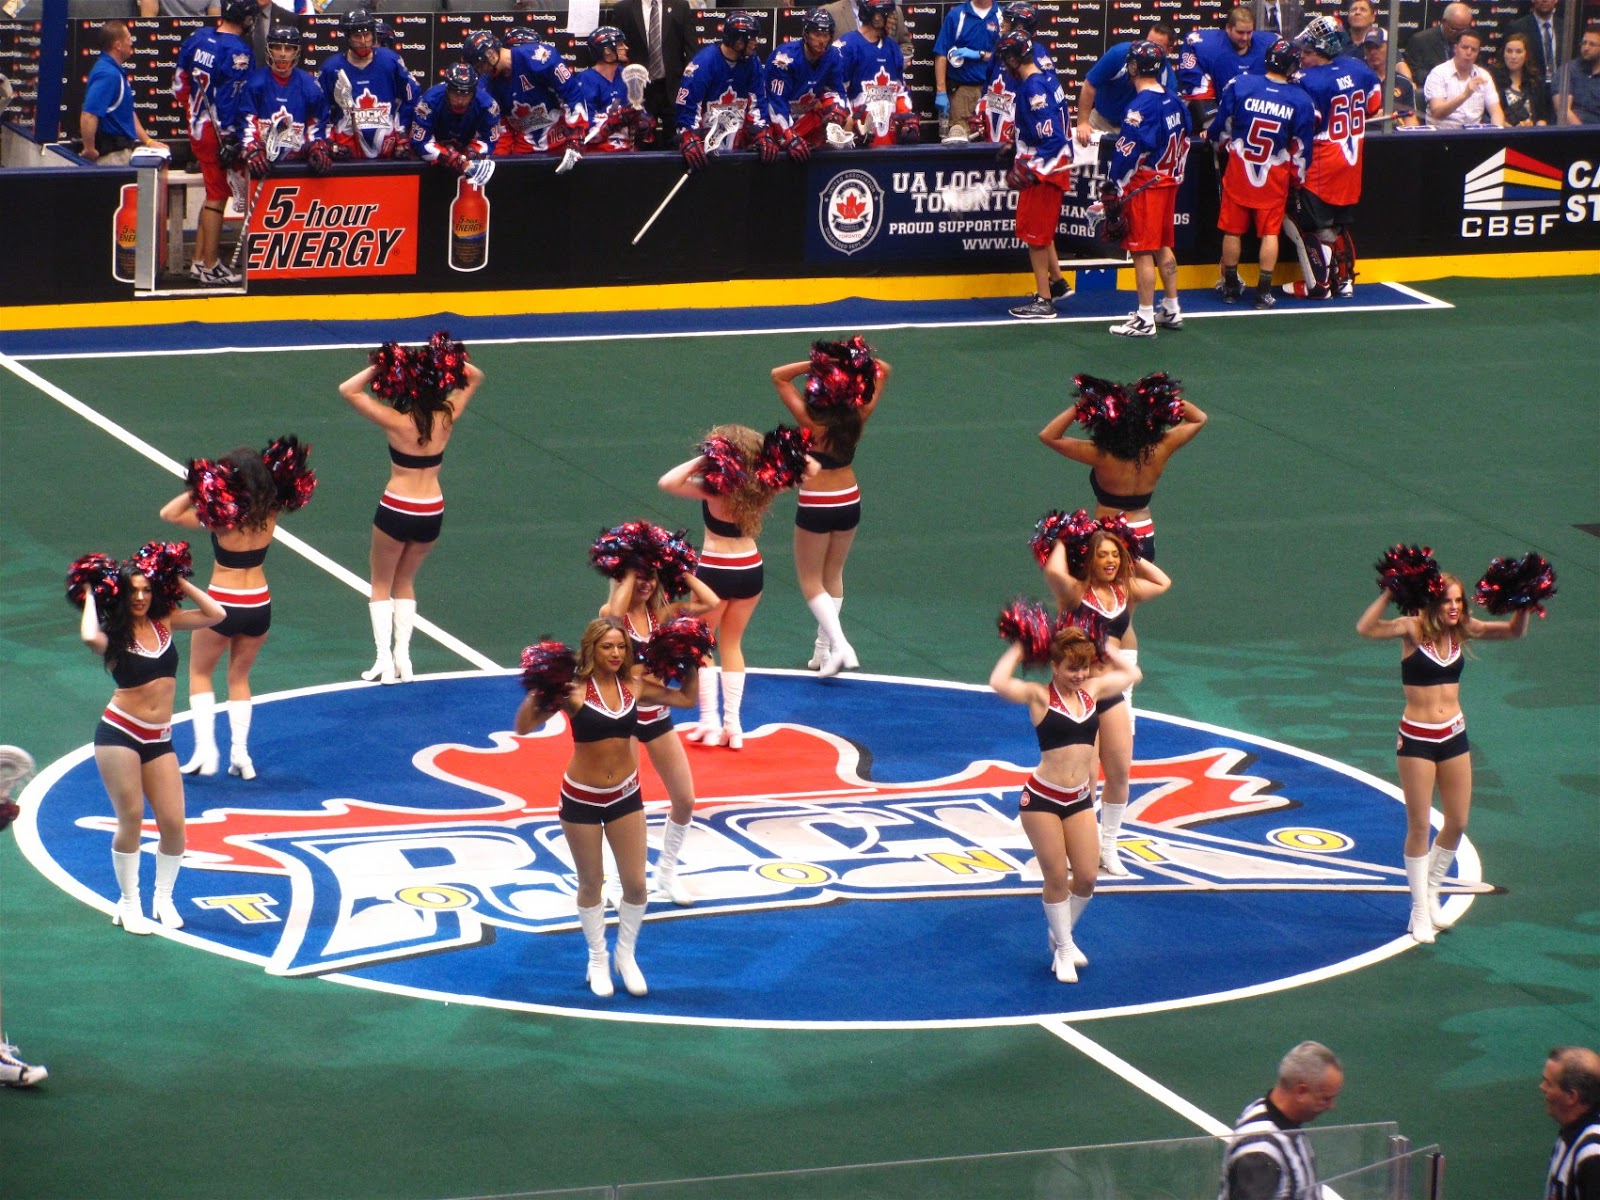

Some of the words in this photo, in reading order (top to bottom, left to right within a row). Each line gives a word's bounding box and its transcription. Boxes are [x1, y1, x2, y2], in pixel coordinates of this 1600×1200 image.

[194, 48, 215, 69] DOYLE
[519, 74, 535, 92] A
[554, 62, 572, 84] 16
[1244, 98, 1294, 122] CHAPMAN
[1328, 89, 1366, 142] 66
[1115, 136, 1136, 157] 44
[1243, 117, 1282, 164] 5
[893, 172, 929, 194] UA
[263, 186, 379, 230] 5-hour
[888, 222, 934, 235] PROUD
[1461, 213, 1561, 238] CBSF
[247, 228, 405, 271] ENERGY
